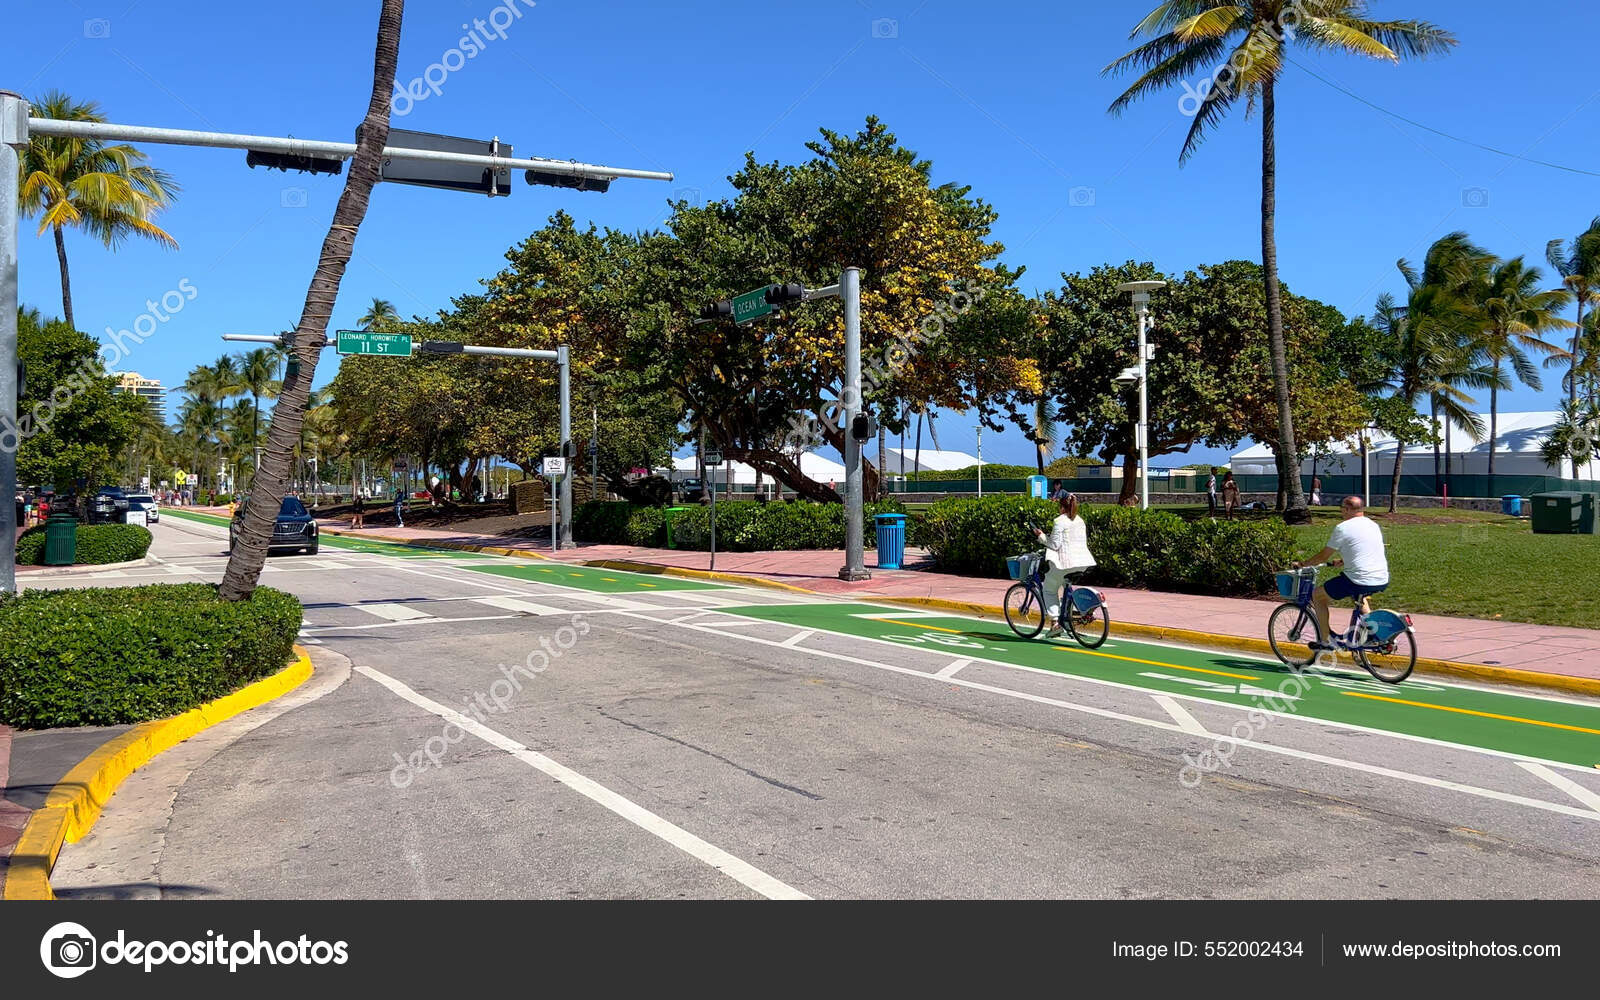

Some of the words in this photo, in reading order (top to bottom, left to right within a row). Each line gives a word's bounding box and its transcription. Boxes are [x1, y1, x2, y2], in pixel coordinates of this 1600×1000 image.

[738, 299, 757, 314] OCEAN
[361, 341, 370, 353] 11
[377, 343, 389, 352] ST
